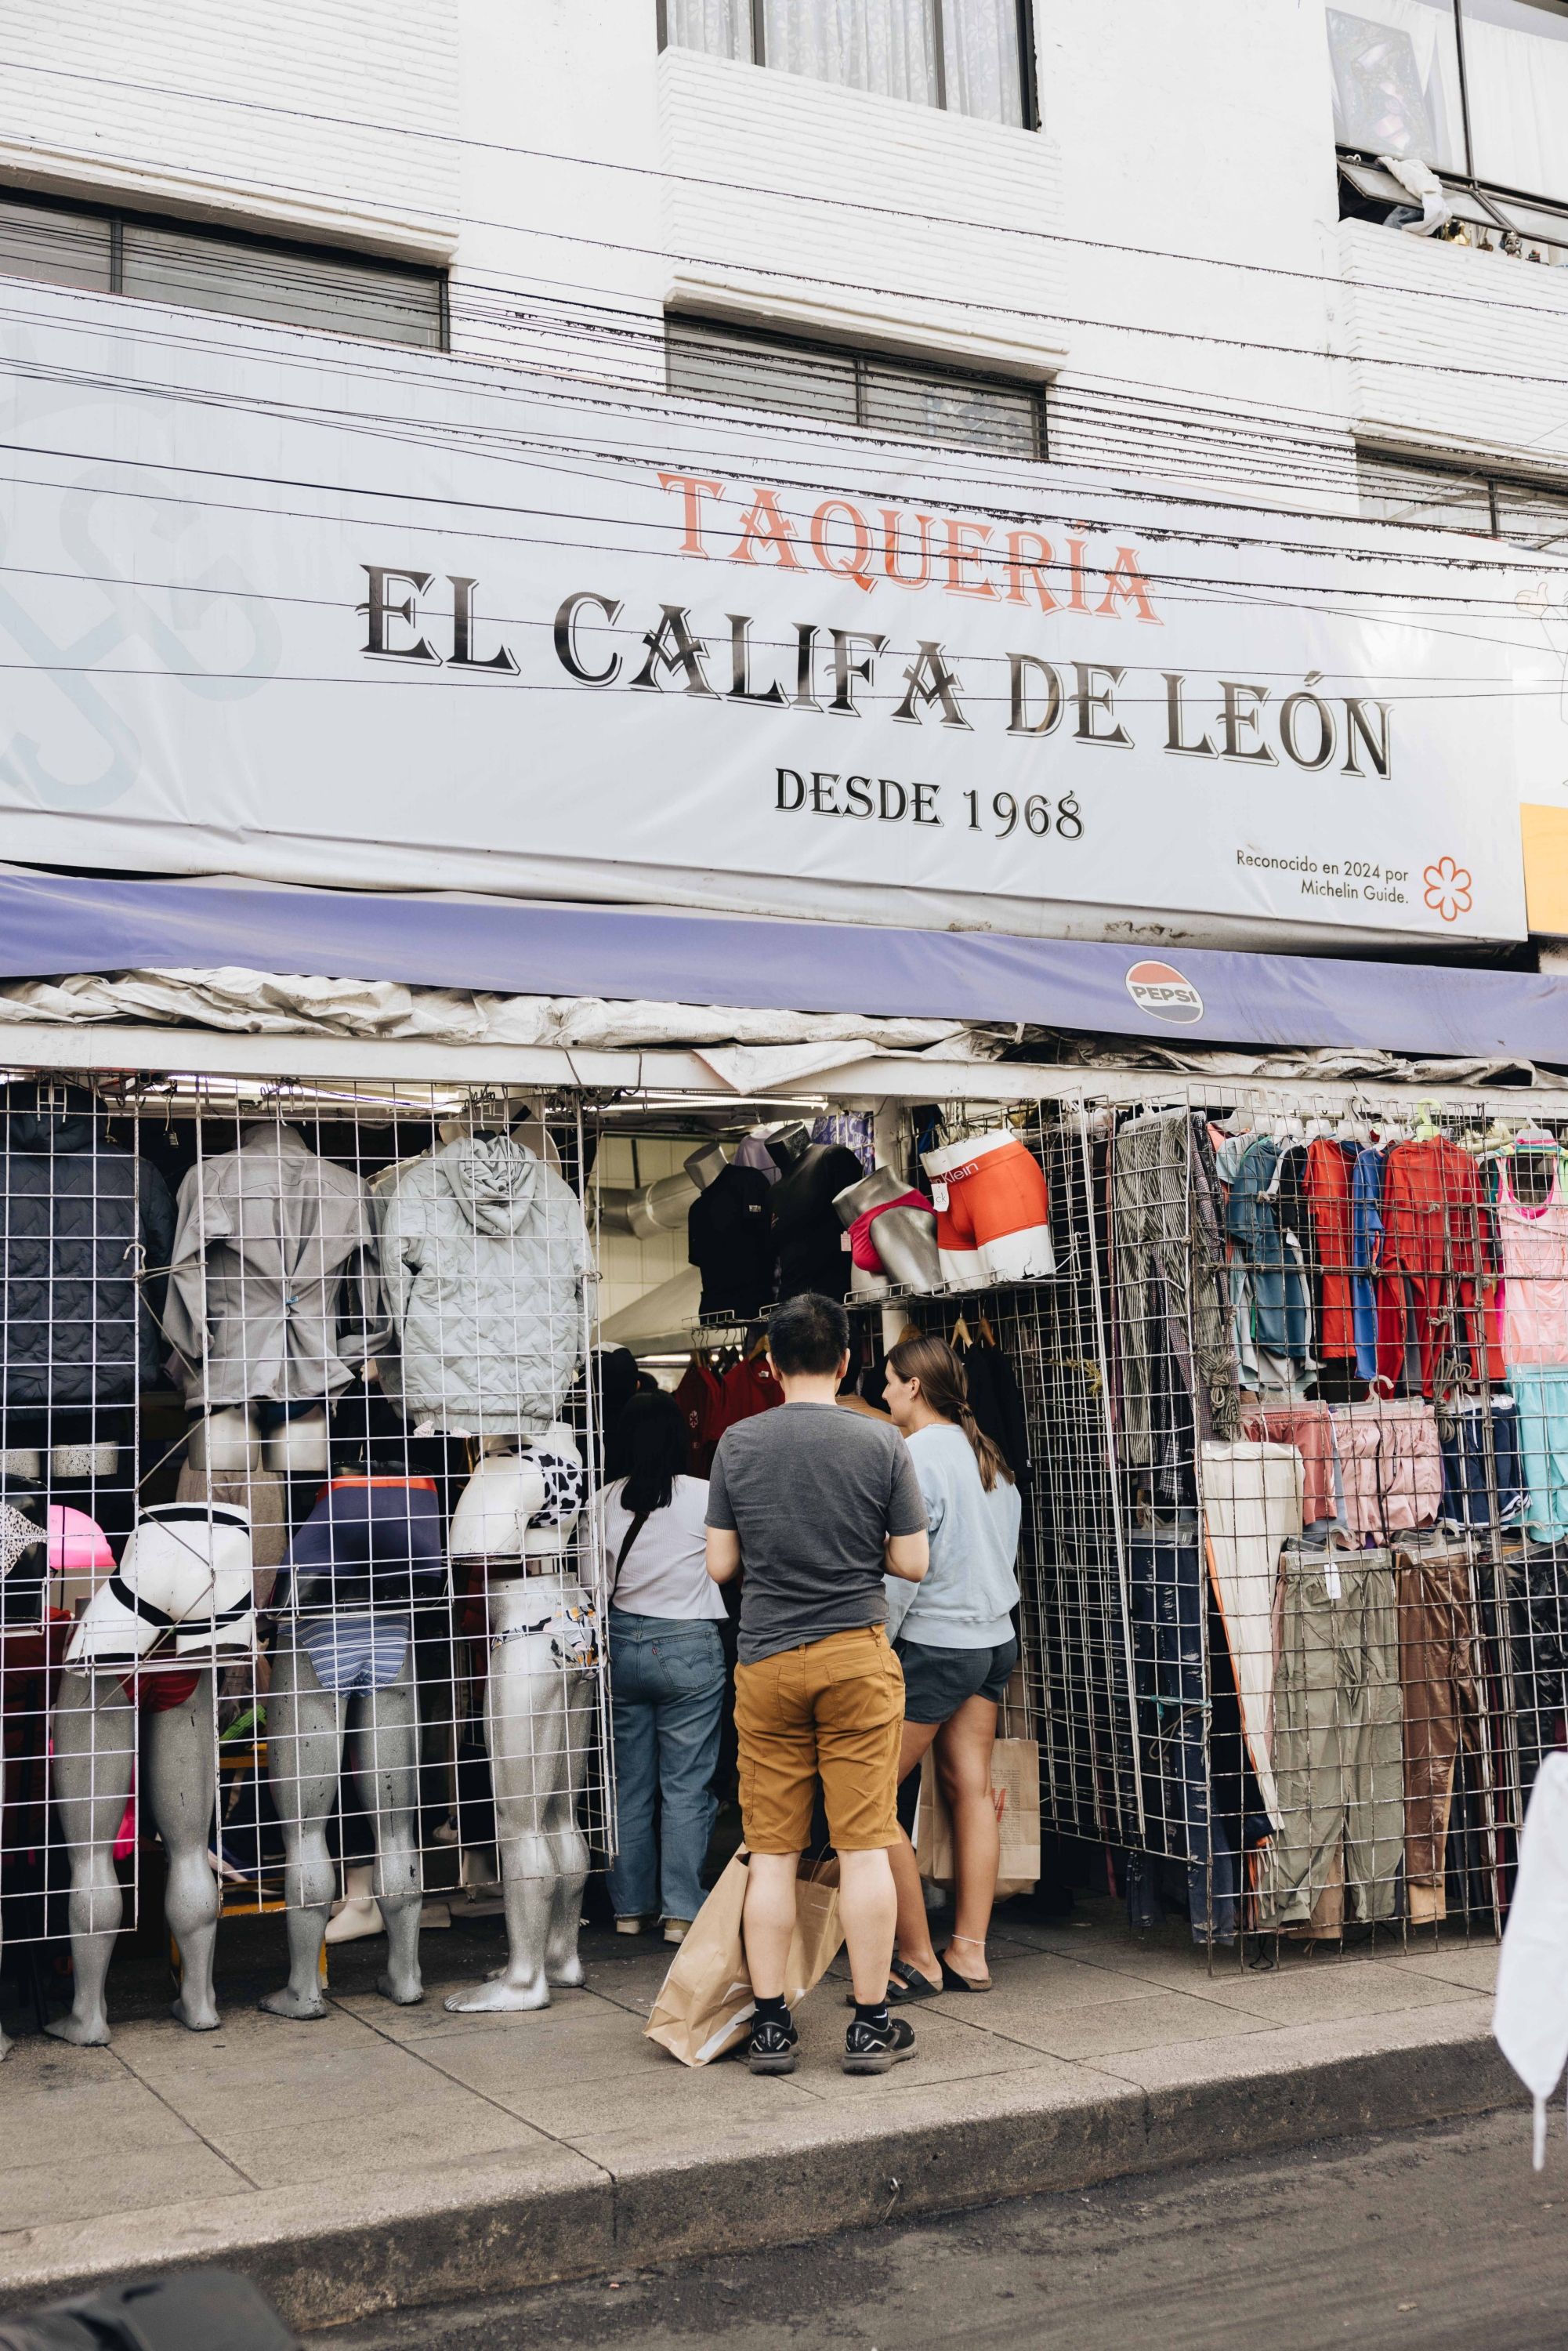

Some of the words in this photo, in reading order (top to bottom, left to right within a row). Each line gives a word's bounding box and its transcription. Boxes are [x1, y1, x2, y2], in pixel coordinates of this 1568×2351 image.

[656, 472, 1164, 625] TAQUERÍA
[355, 563, 520, 676] EL
[552, 591, 974, 730] CALIFA
[1005, 652, 1135, 749] DE
[1161, 670, 1394, 780] LEÓN
[775, 767, 944, 828] DESDE
[962, 789, 1085, 839] 1968
[1237, 850, 1317, 872] Reconocido
[1323, 864, 1338, 875] en
[1344, 861, 1381, 878] 2024
[1385, 869, 1409, 884] por
[1301, 879, 1358, 899] Michelin
[1363, 886, 1409, 904] Guide.
[1132, 986, 1197, 1003] PEPSI
[941, 1163, 979, 1184] Klein
